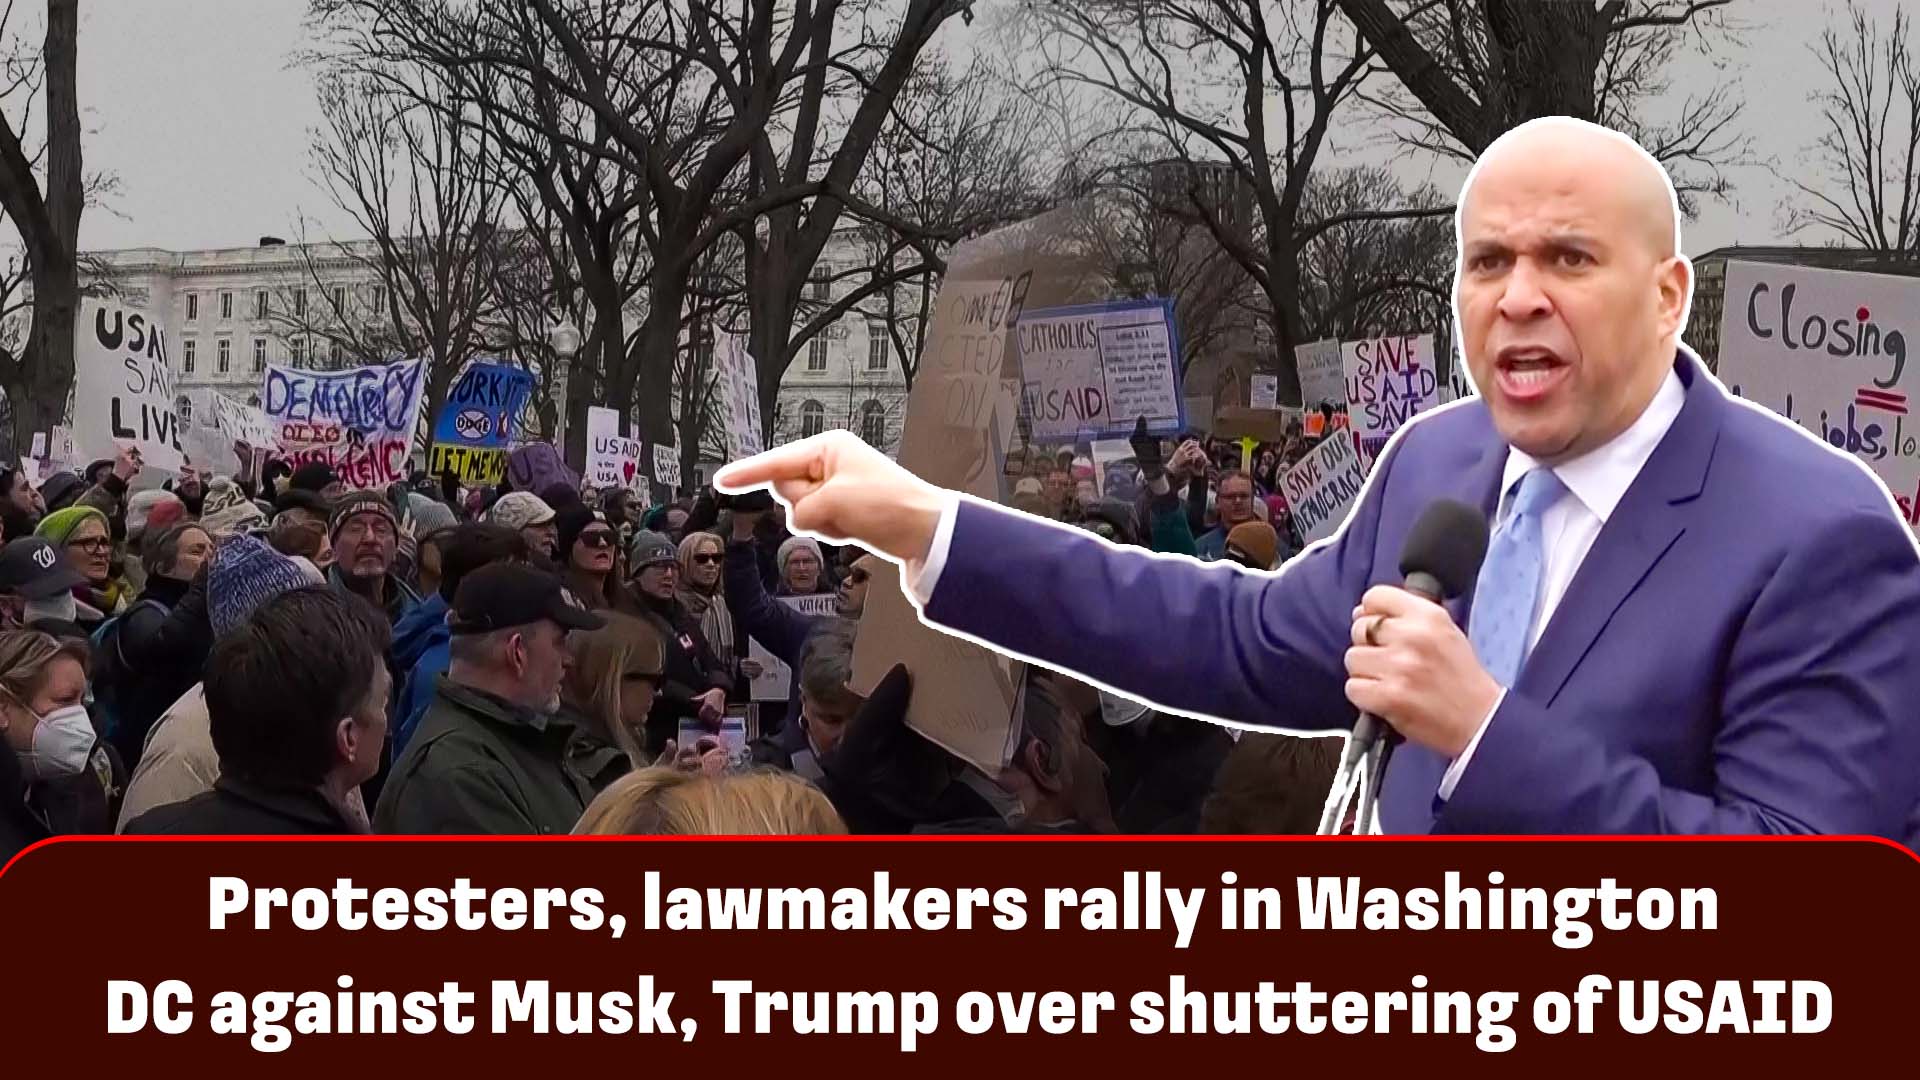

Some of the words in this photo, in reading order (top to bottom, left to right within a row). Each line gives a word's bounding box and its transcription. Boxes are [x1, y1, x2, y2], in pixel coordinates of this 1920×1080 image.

[96, 308, 168, 368] USAI
[1018, 319, 1098, 354] CATHOLICS
[1355, 335, 1420, 377] SAVE
[1747, 282, 1907, 389] Closing
[125, 357, 171, 400] SAV
[1345, 368, 1437, 405] USAID
[1029, 387, 1103, 422] USAID
[595, 436, 640, 459] USAID
[1894, 415, 1920, 457] lo
[597, 471, 619, 482] USA
[1286, 457, 1323, 502] SAVE
[1320, 431, 1356, 472] OUR
[1294, 460, 1367, 536] DEMOCRACY
